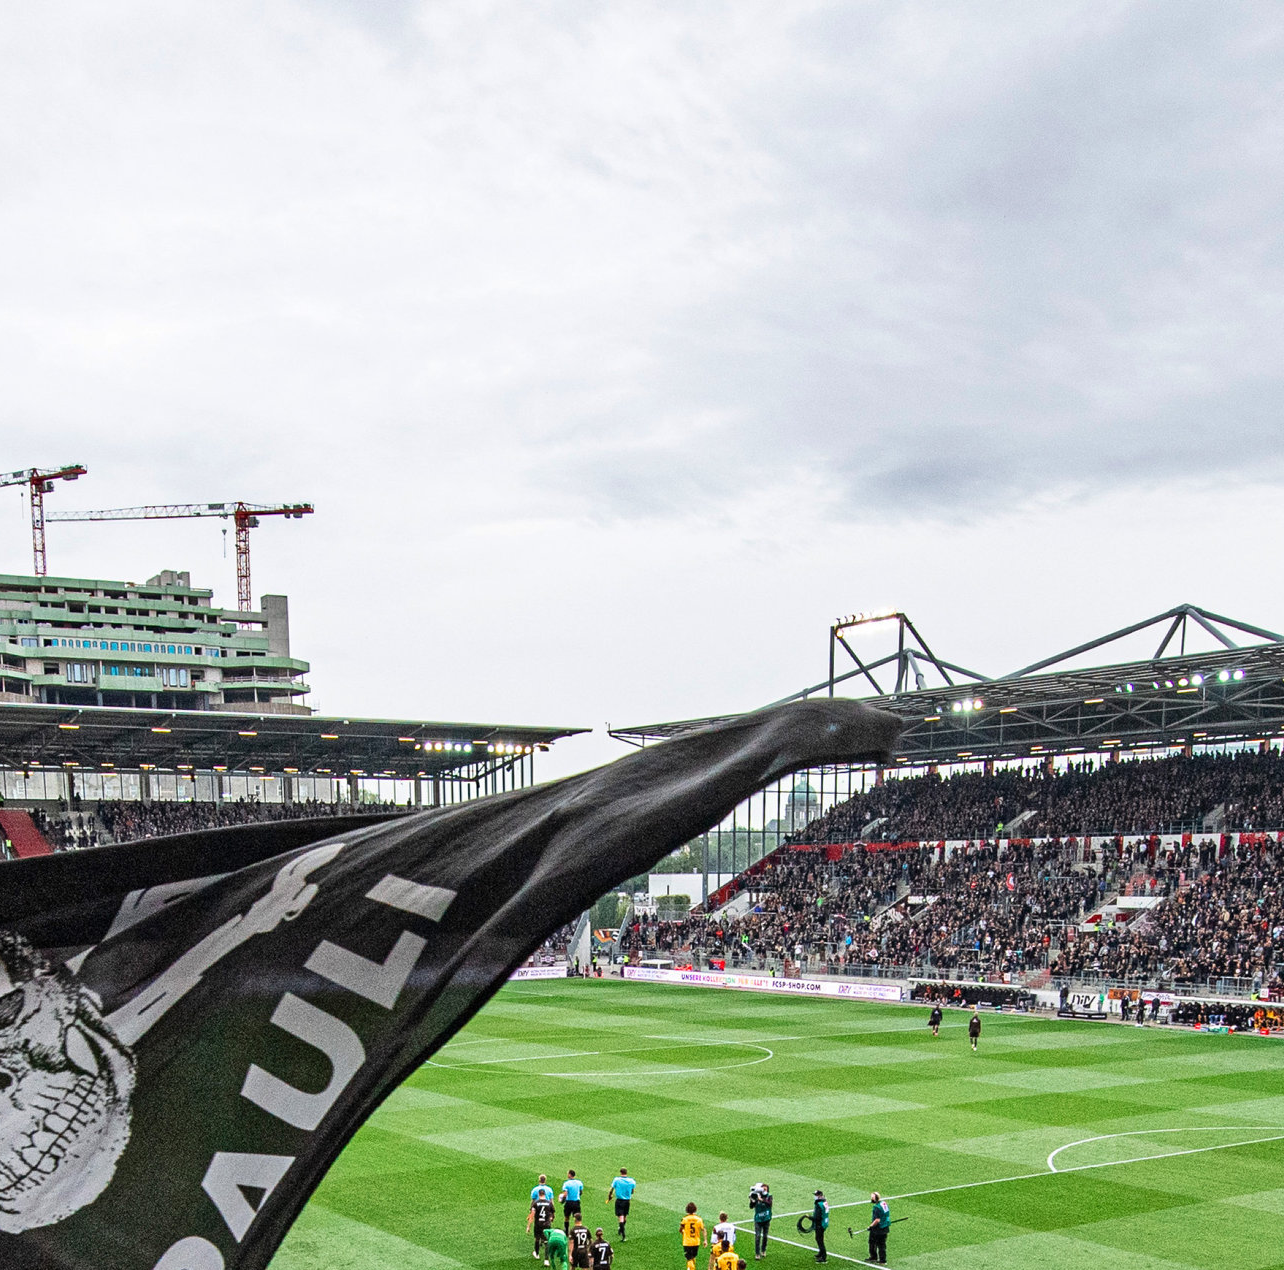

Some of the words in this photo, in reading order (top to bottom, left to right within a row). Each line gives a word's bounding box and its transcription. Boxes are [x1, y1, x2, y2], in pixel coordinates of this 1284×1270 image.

[539, 1206, 546, 1218] 4
[690, 1223, 696, 1234] 5
[576, 1233, 587, 1247] 19
[599, 1247, 606, 1260] 7
